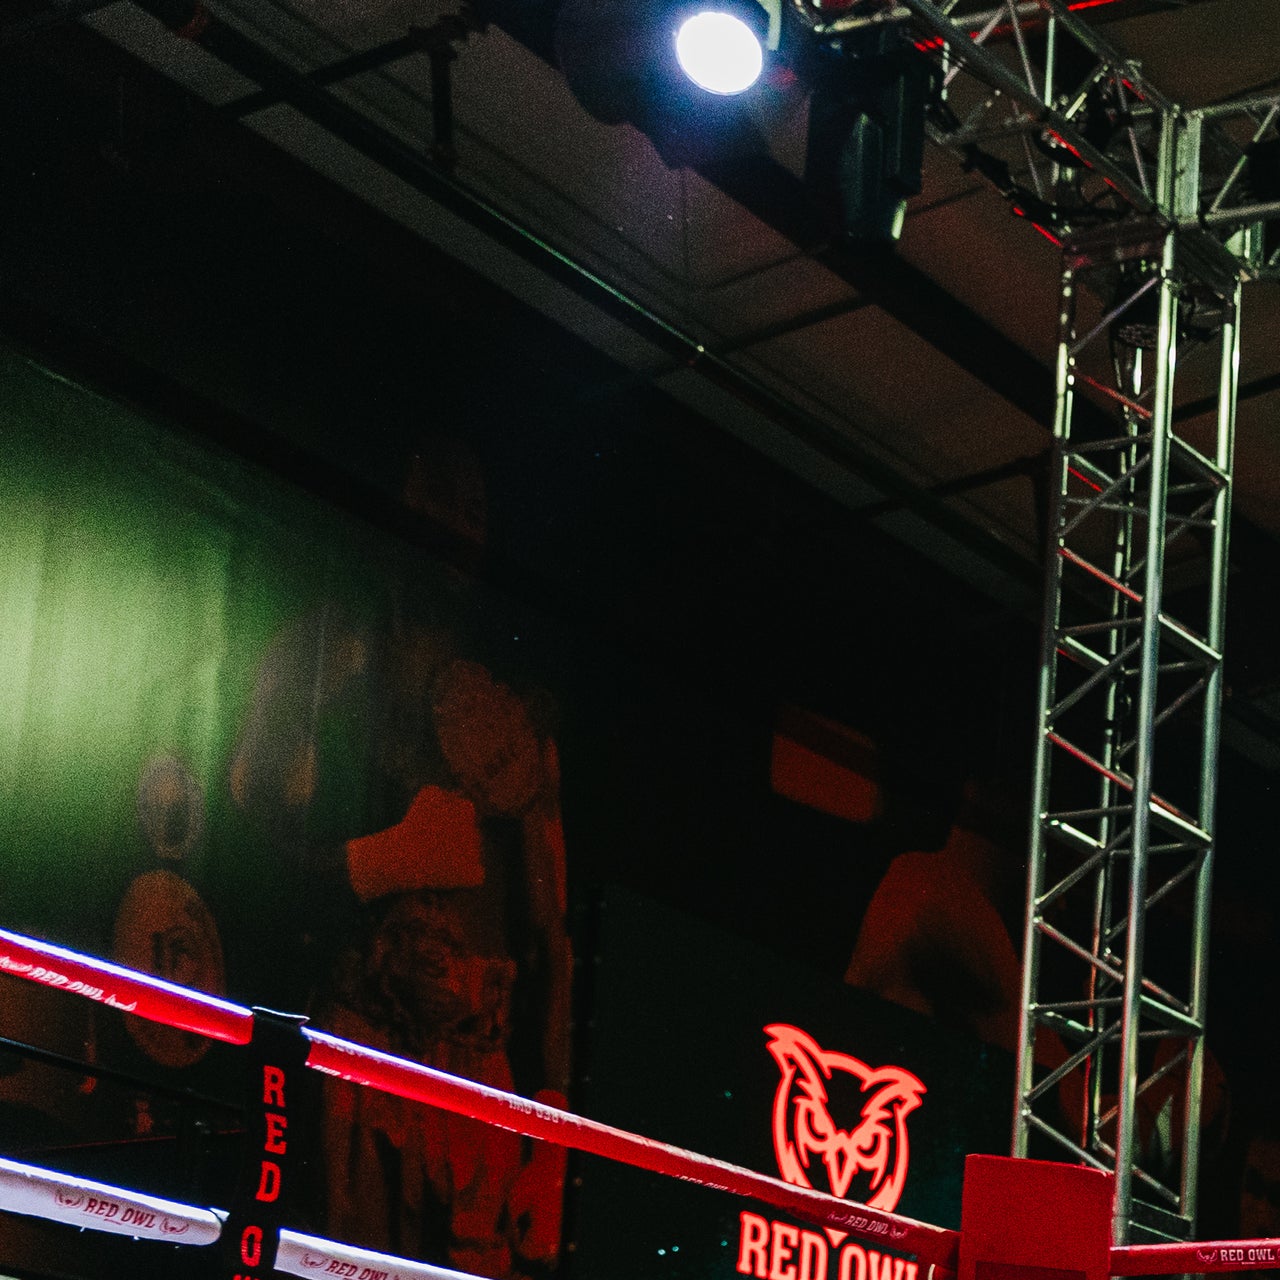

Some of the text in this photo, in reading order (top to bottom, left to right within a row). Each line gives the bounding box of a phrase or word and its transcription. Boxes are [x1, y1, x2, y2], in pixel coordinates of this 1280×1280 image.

[255, 1065, 287, 1202] RED
[83, 1198, 156, 1229] RED OWL
[844, 1214, 890, 1236] RED OWL
[1220, 1247, 1276, 1262] RED OWL
[324, 1259, 357, 1278] RED
